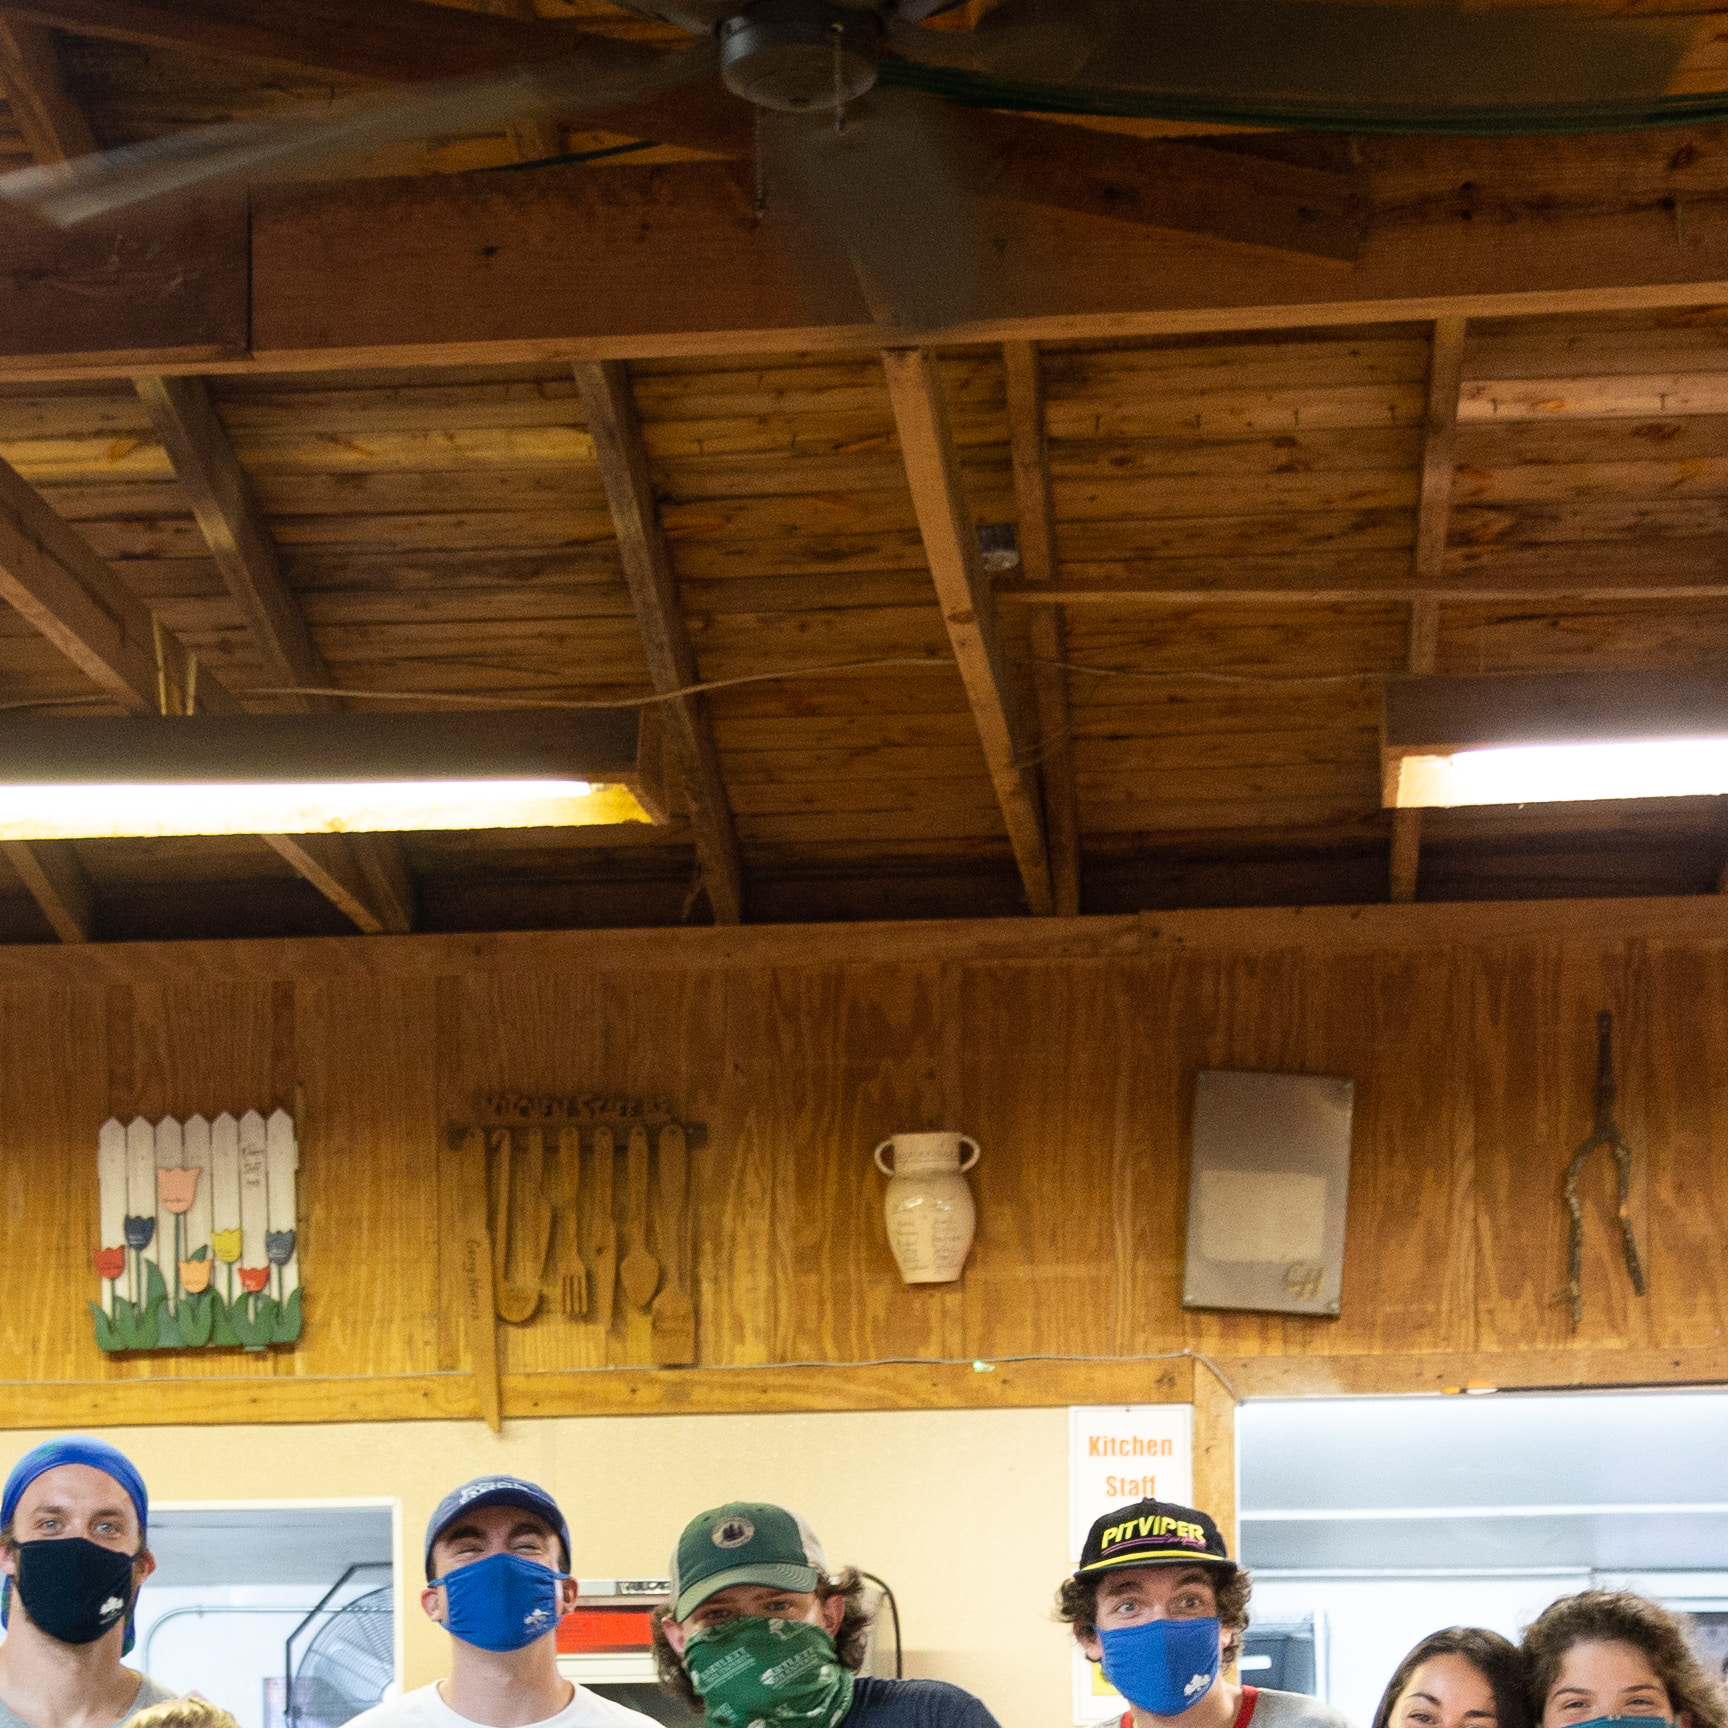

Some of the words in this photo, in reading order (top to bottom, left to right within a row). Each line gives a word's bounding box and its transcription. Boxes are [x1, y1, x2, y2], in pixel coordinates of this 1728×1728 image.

[1088, 1436, 1172, 1457] Kitchen
[1105, 1476, 1156, 1497] Staff
[1101, 1515, 1206, 1549] PITVIPER
